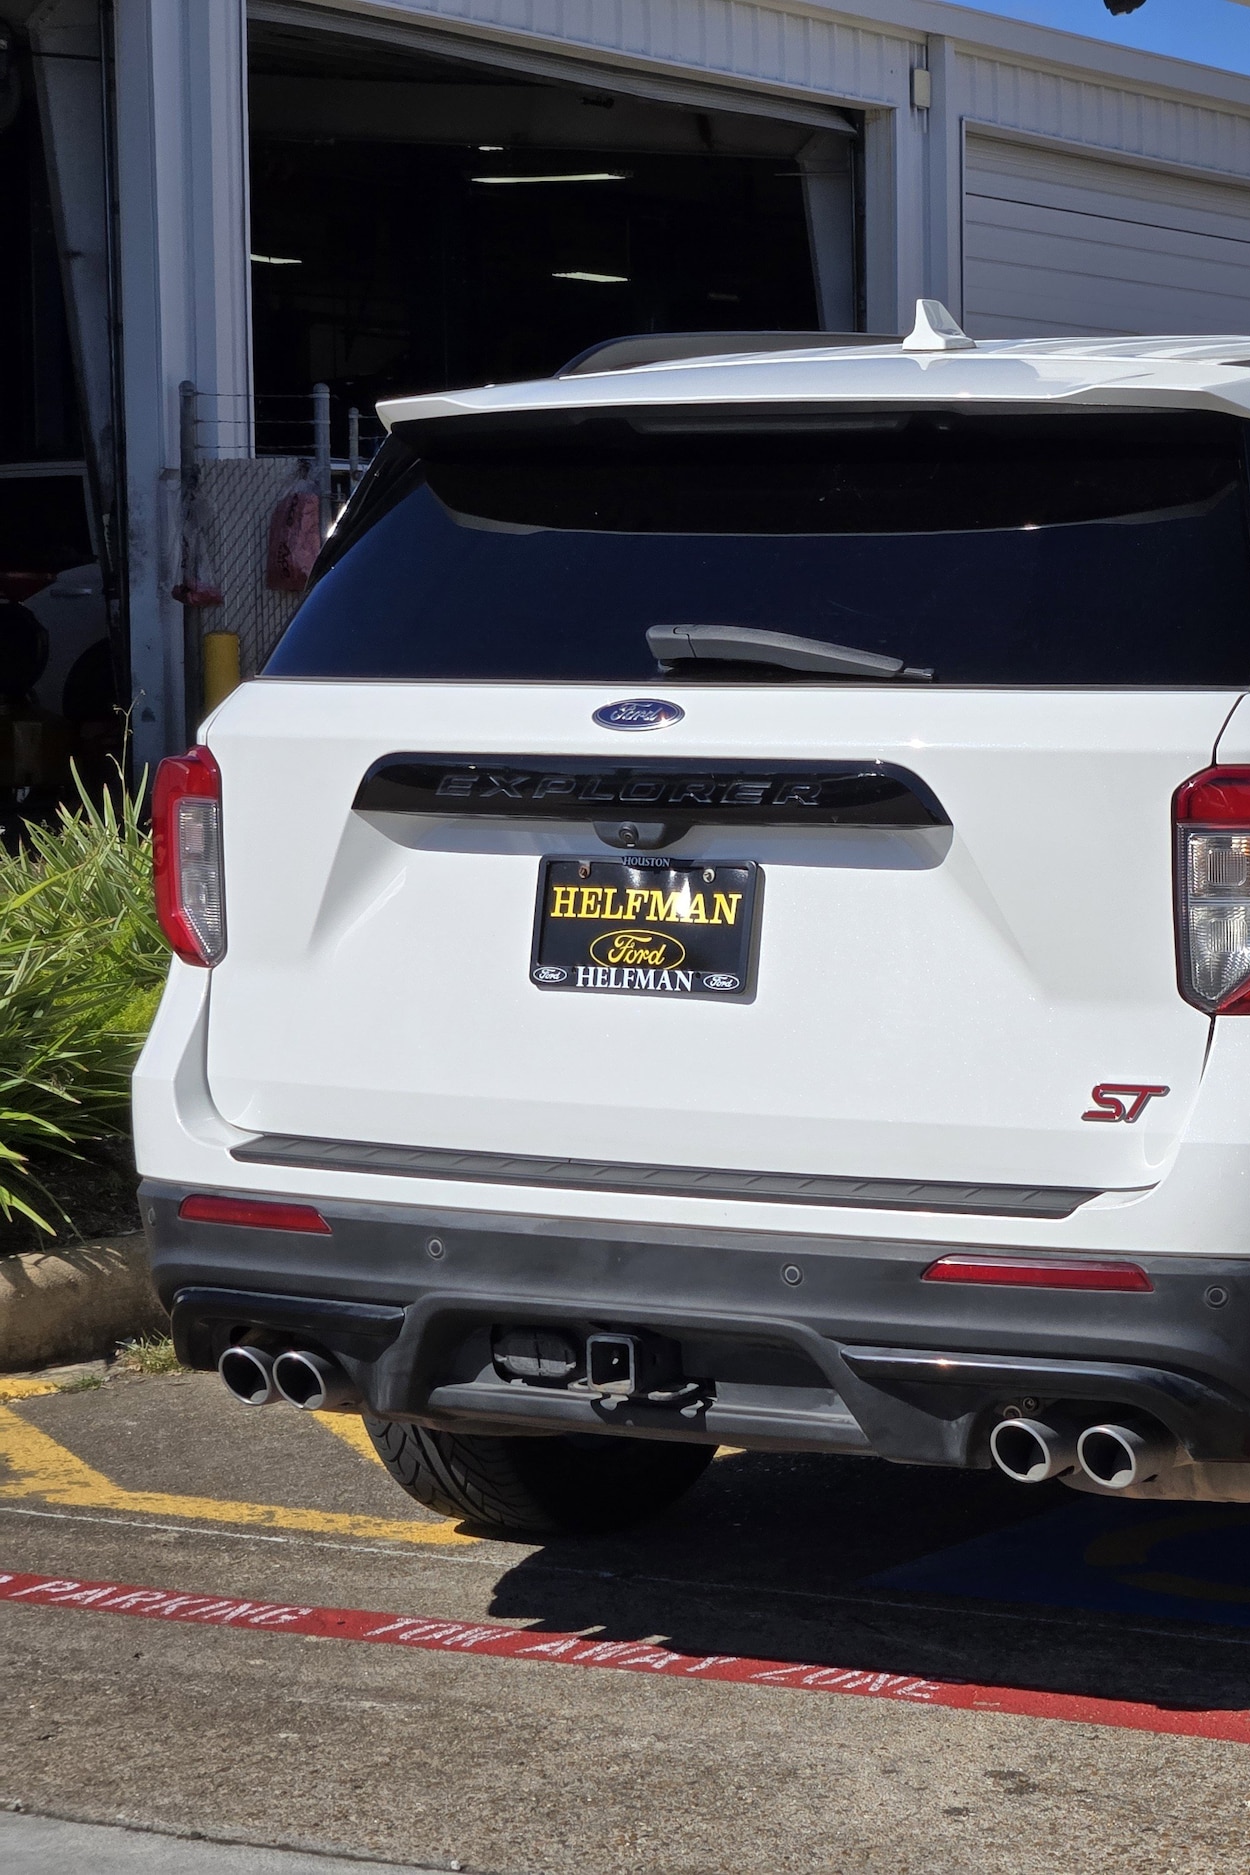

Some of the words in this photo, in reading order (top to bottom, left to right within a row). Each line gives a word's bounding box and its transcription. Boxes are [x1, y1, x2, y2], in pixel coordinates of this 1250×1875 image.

[610, 702, 663, 721] Ford
[435, 775, 823, 806] EXPLORER
[623, 856, 671, 868] HOUSTON
[550, 886, 742, 925] HELFMAN
[607, 934, 667, 965] Ford
[576, 966, 694, 992] HELFMAN
[1081, 1083, 1170, 1123] ST
[7, 1580, 313, 1624] PARKING
[749, 1663, 940, 1699] ZONE
